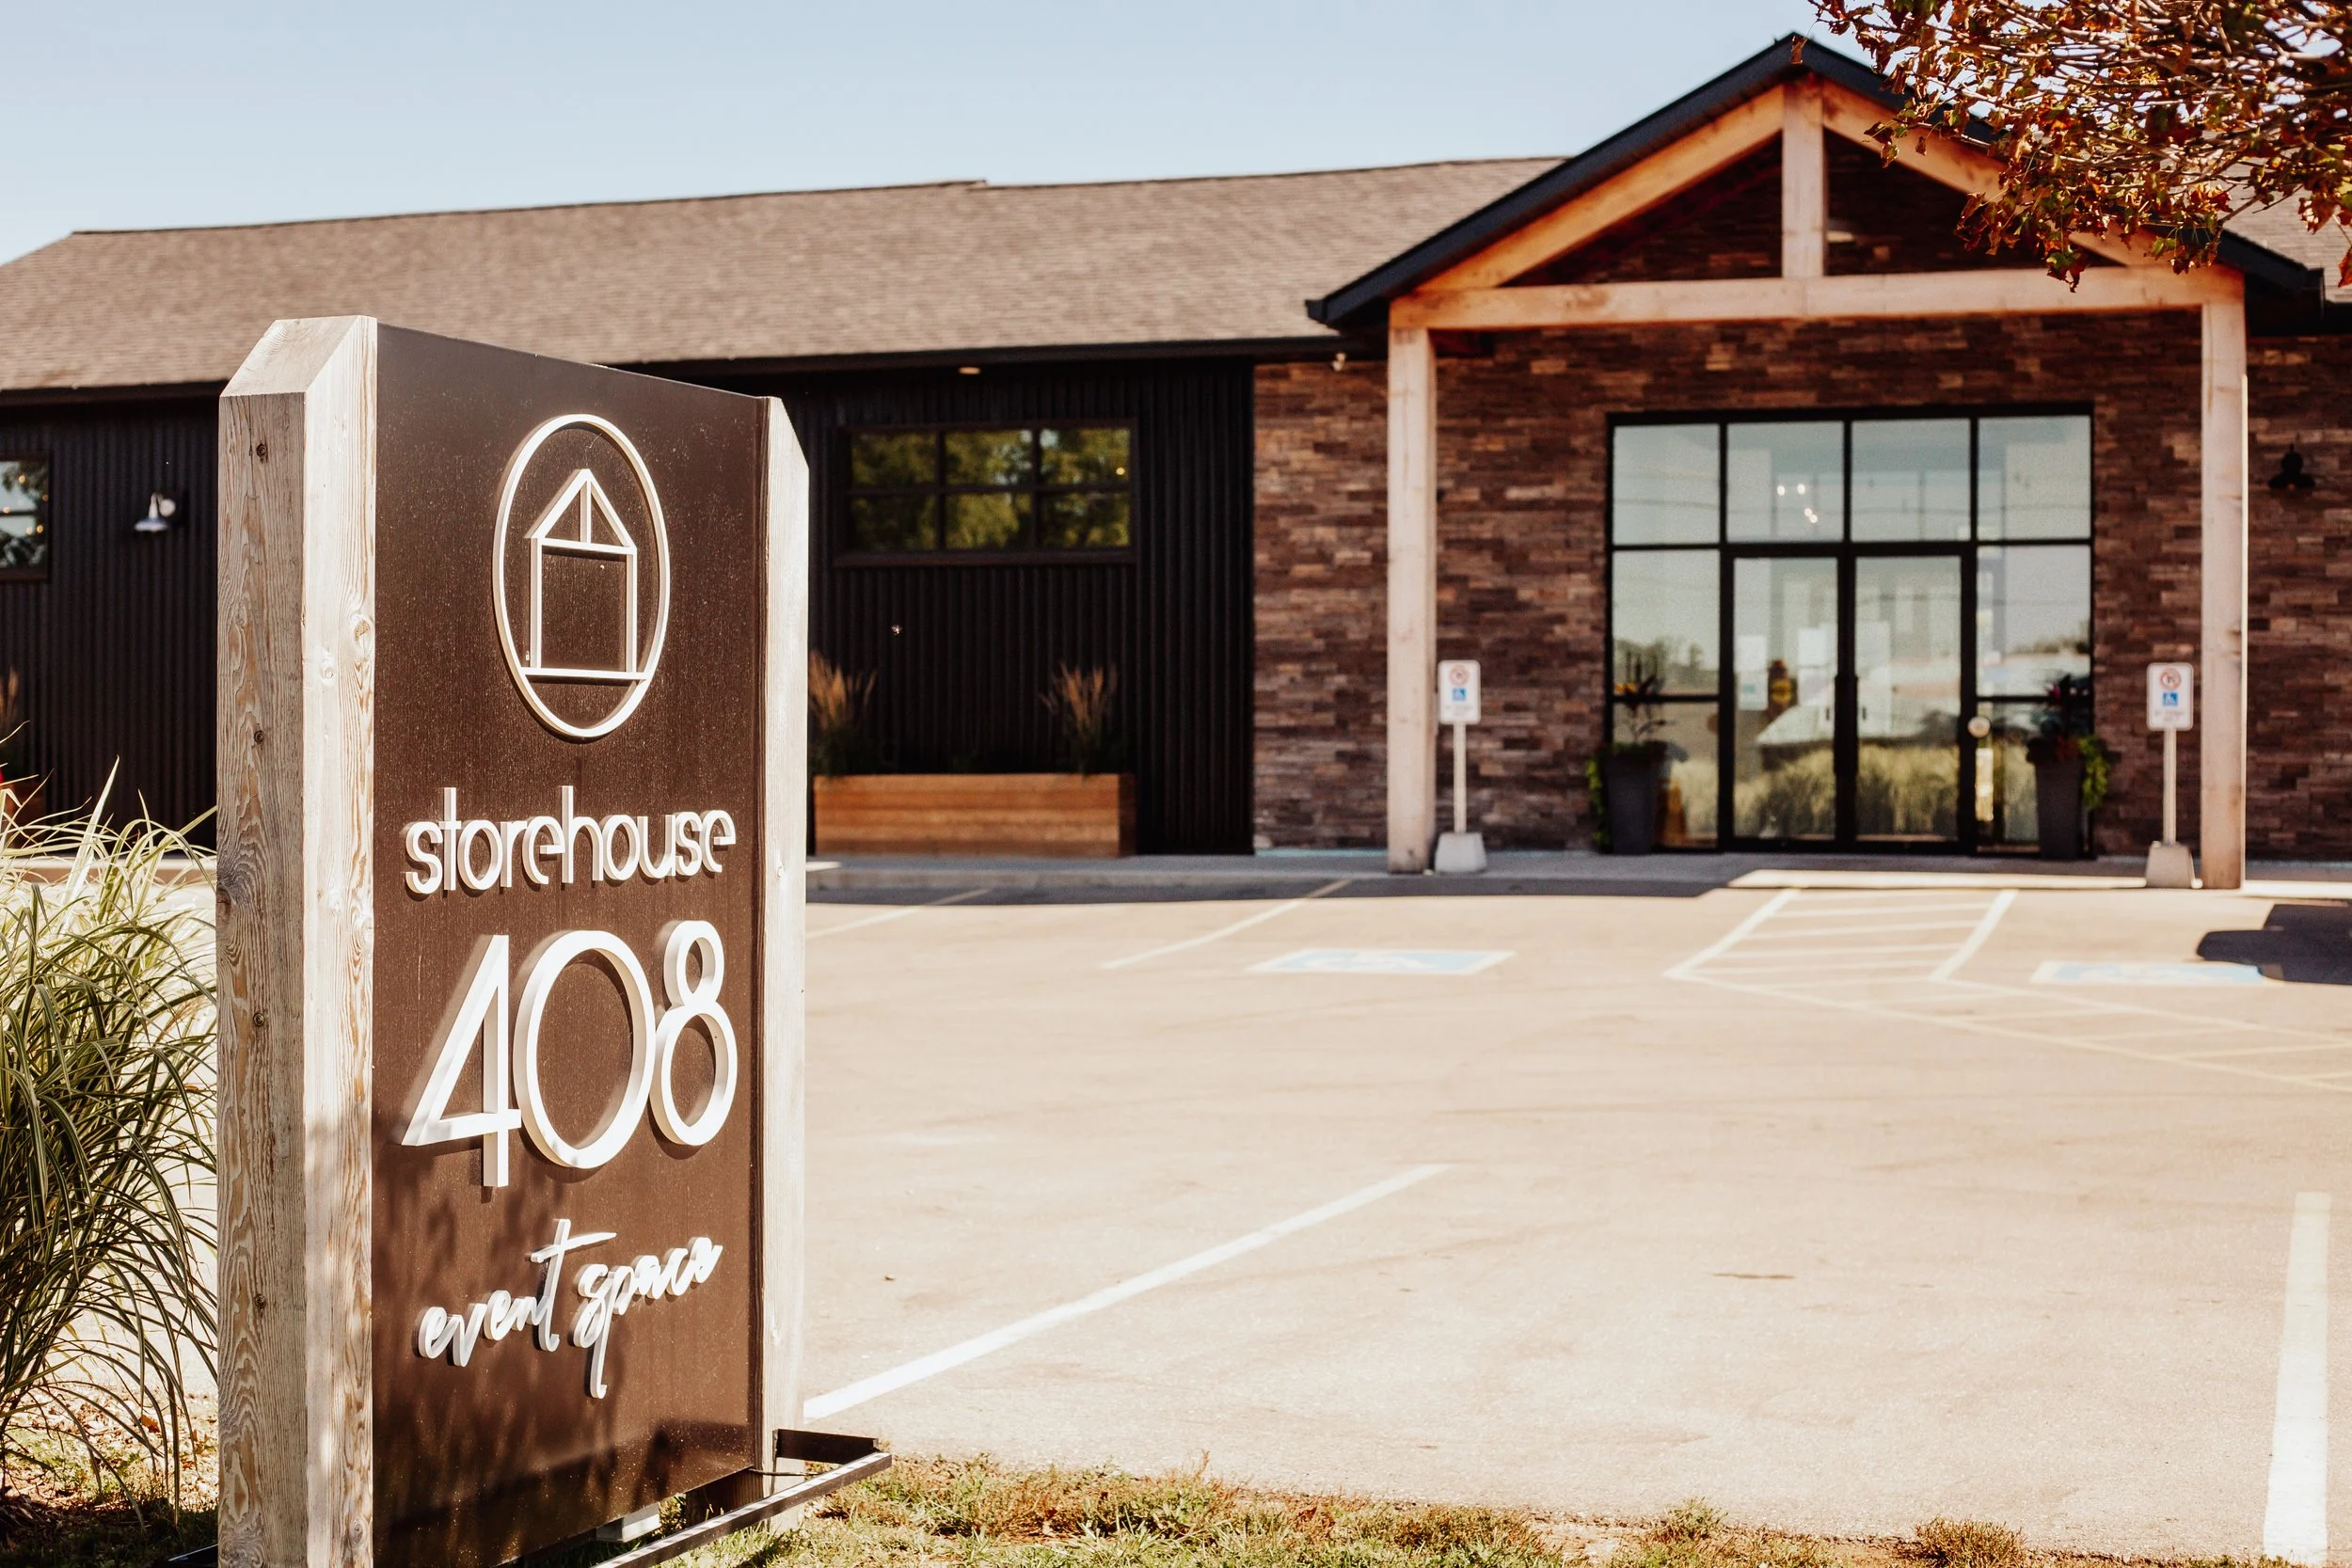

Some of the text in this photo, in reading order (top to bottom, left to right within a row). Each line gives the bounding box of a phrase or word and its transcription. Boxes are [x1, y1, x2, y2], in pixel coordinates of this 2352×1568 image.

[405, 785, 736, 894] storehouse
[402, 920, 738, 1188] 408
[418, 1218, 723, 1399] event space
